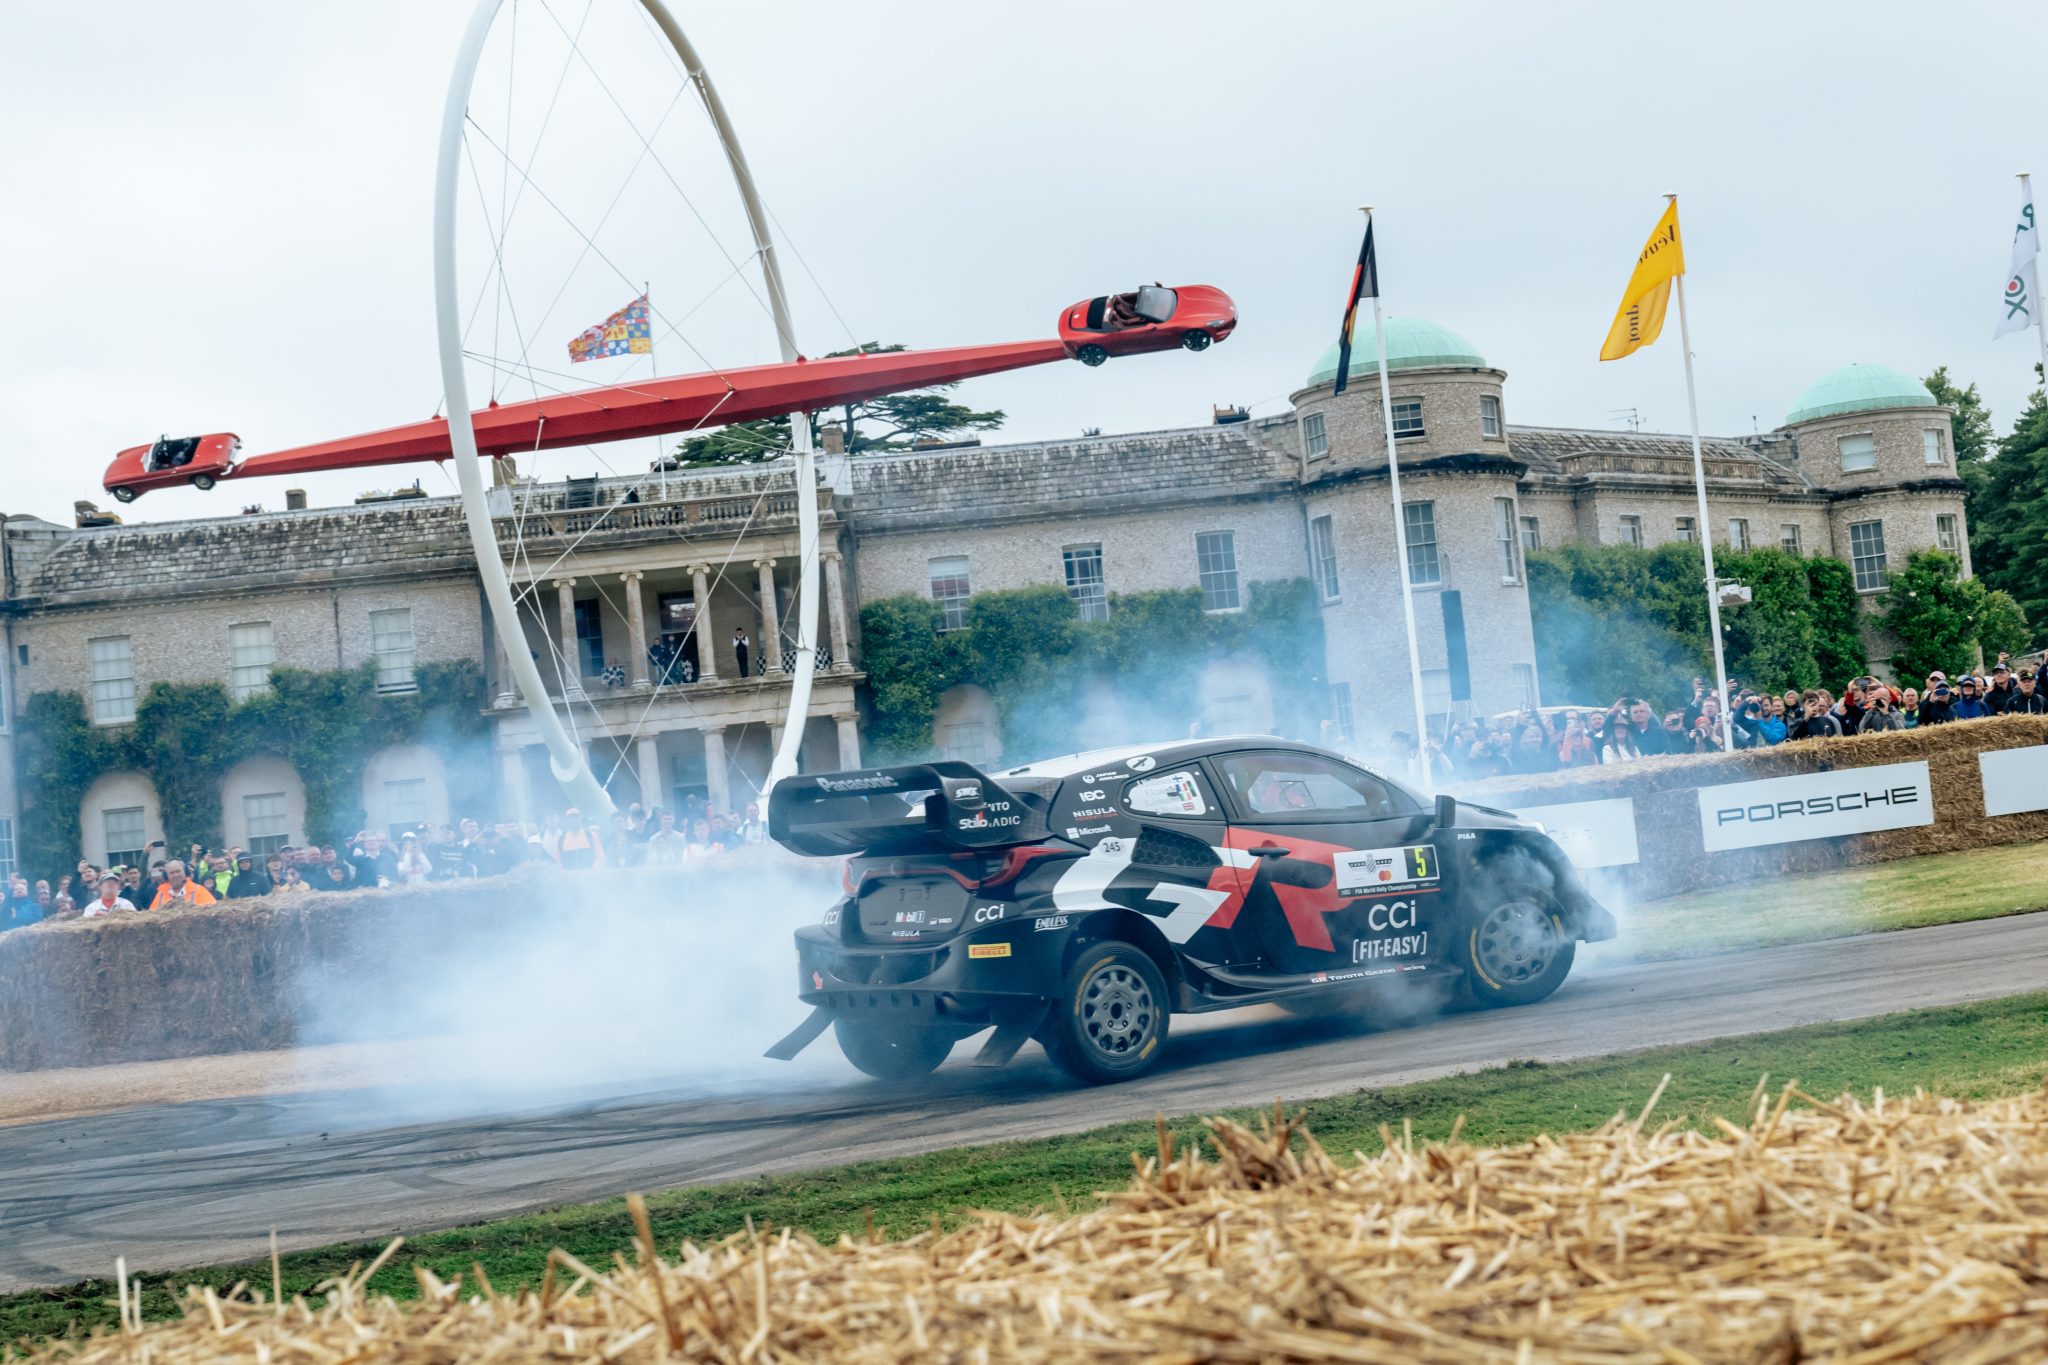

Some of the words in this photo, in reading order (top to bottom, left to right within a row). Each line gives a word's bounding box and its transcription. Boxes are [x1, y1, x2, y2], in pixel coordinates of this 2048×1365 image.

[816, 772, 899, 793] Panasonic
[1072, 806, 1117, 818] NISULA
[1717, 785, 1919, 827] PORSCHE
[1078, 824, 1112, 836] Microsoft
[1457, 832, 1476, 841] PIAA
[1102, 841, 1121, 853] 245
[1414, 848, 1427, 878] 5
[1363, 887, 1376, 895] World
[1034, 915, 1070, 931] ENDLESS
[972, 945, 1007, 957] PIRELLI
[1311, 975, 1329, 984] GR
